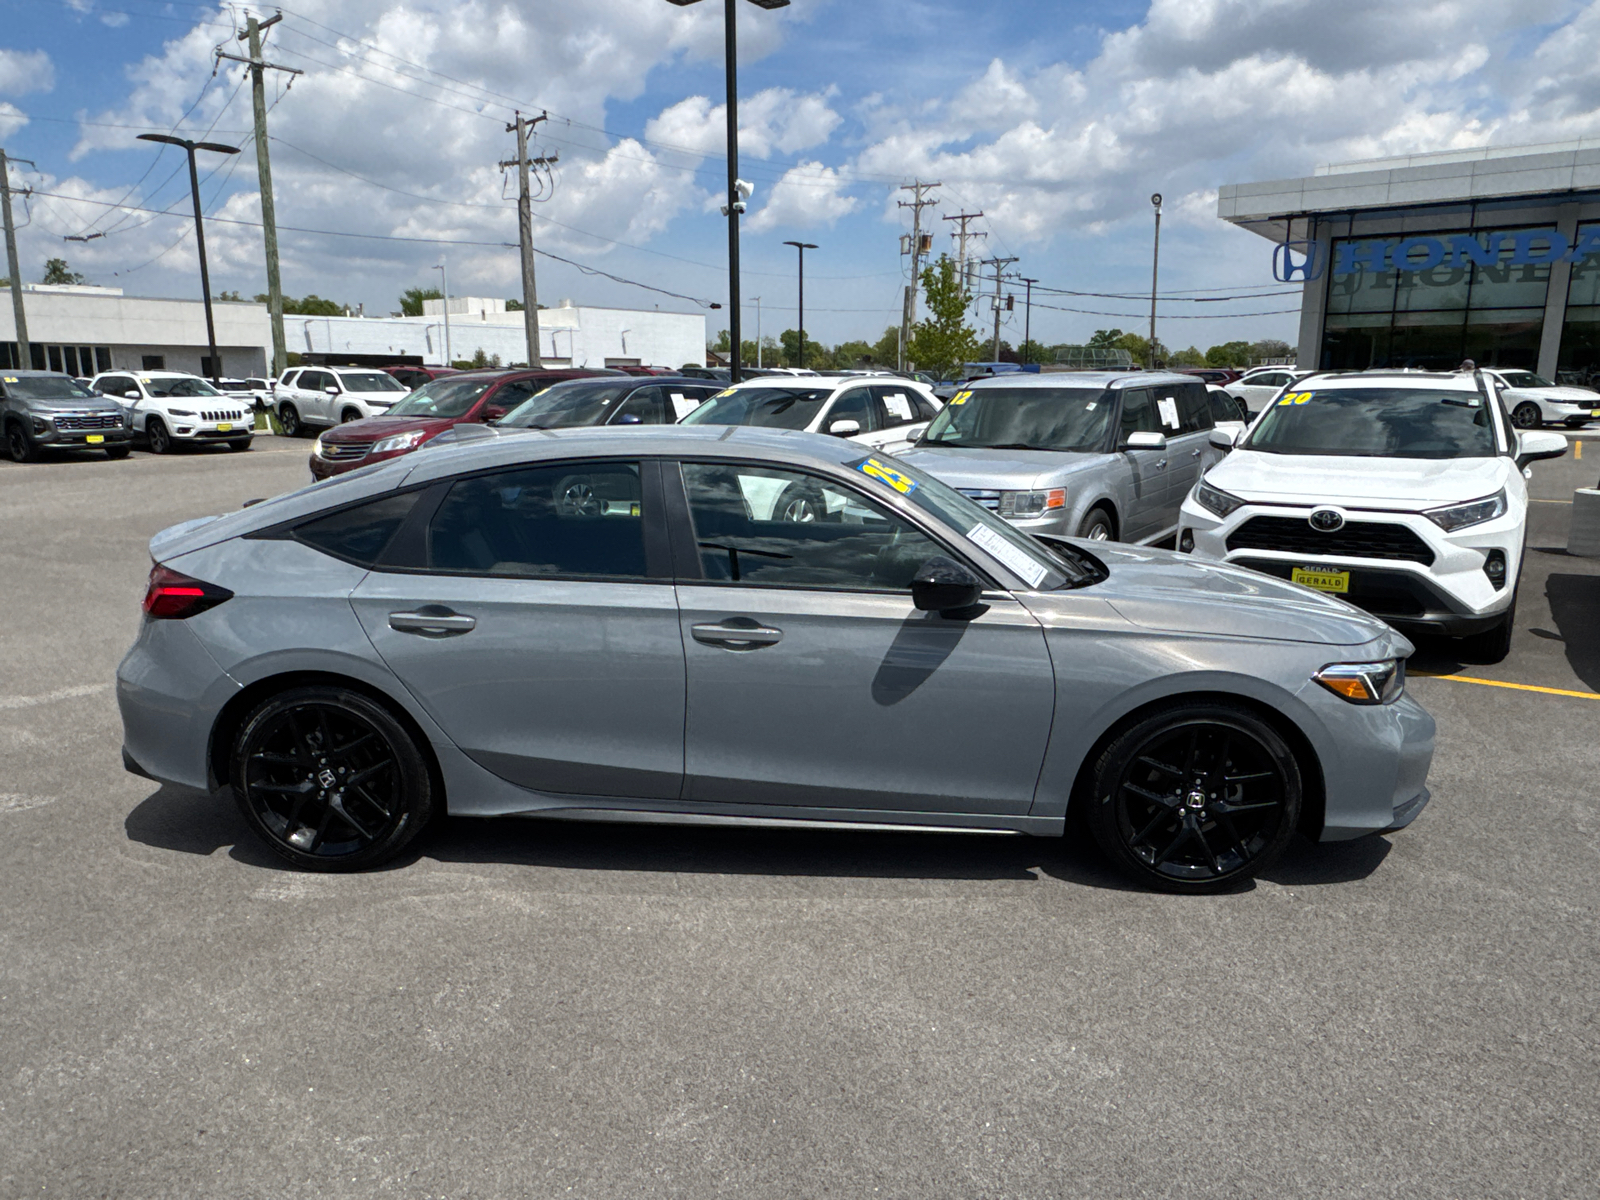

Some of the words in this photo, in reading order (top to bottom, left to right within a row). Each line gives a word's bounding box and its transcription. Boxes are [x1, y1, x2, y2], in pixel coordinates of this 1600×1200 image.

[1334, 227, 1600, 274] HONDA
[950, 390, 974, 405] 12
[1278, 392, 1313, 405] 20
[1298, 576, 1341, 587] GERALD
